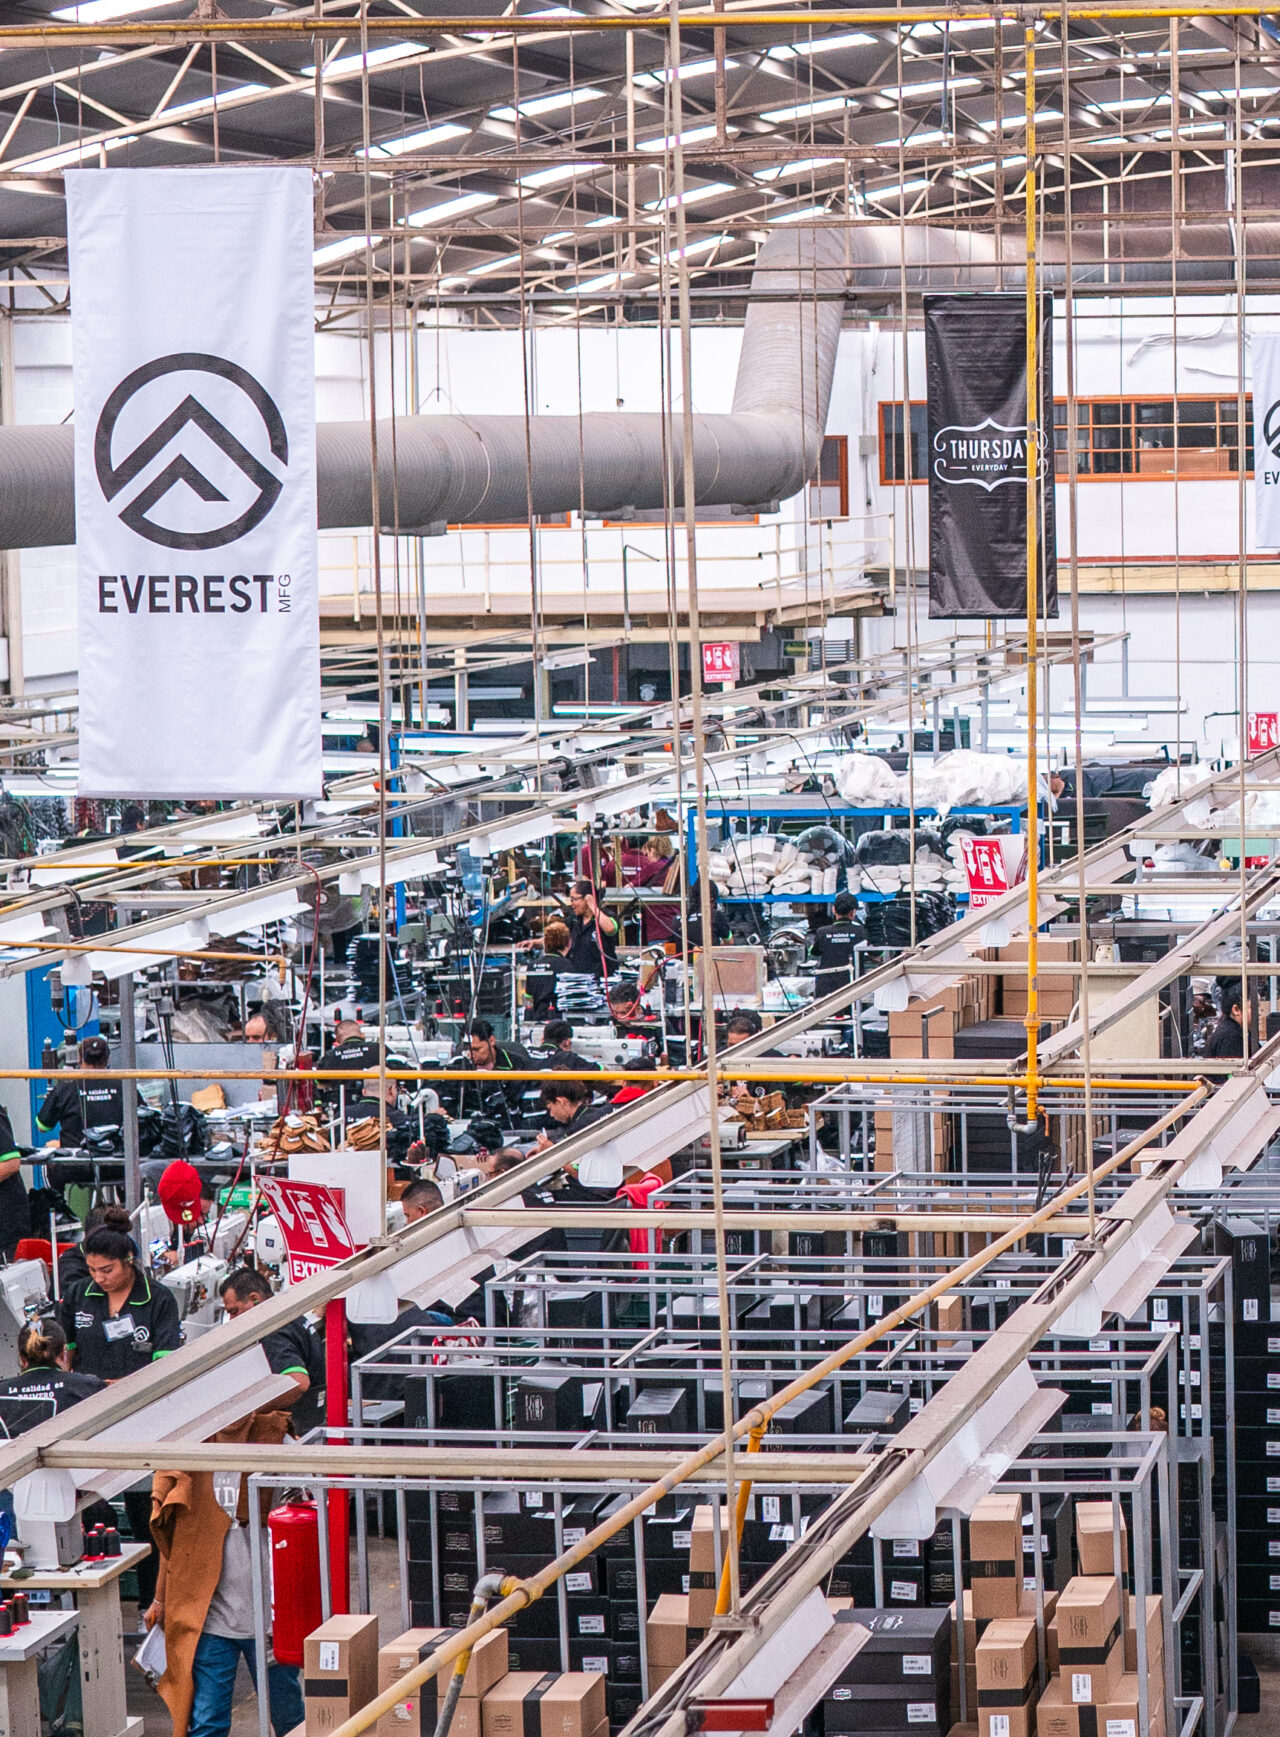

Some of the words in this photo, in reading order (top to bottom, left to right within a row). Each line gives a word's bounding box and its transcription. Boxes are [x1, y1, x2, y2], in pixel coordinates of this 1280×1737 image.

[971, 464, 1009, 472] EVERYDAY
[98, 575, 274, 614] EVEREST
[278, 574, 291, 613] MFG
[21, 1382, 51, 1393] calidad
[54, 1381, 64, 1389] es
